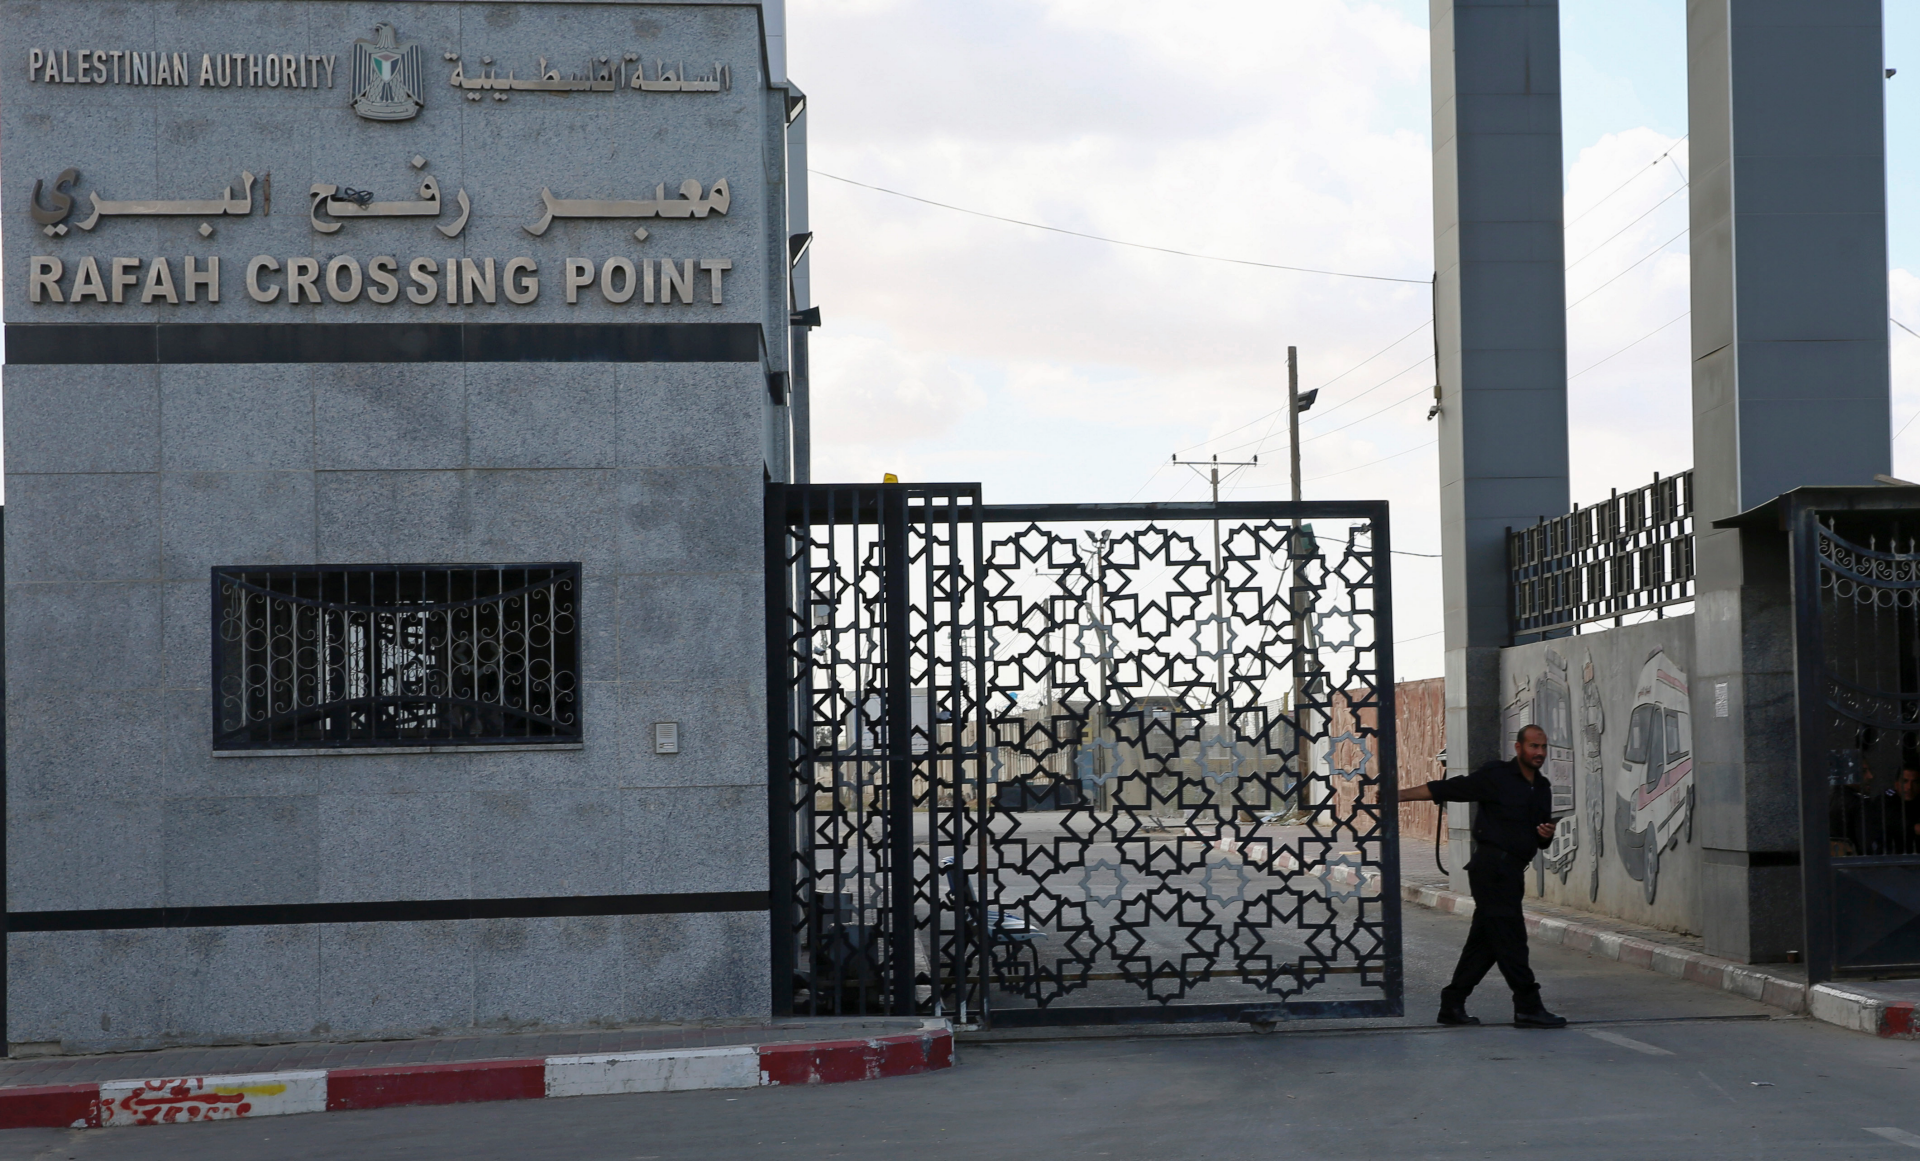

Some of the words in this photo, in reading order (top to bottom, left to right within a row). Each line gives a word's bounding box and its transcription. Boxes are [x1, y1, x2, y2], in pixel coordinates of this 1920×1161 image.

[29, 47, 189, 86] PALESTINIAN
[199, 52, 337, 89] AUTHORITY
[443, 51, 626, 101] الفلسطينية
[624, 52, 731, 92] السلطة
[30, 166, 272, 238] البري
[309, 153, 471, 238] رفح
[520, 177, 731, 243] معبر
[28, 254, 220, 304] RAFAH
[245, 253, 541, 305] CROSSING
[565, 255, 733, 305] POINT
